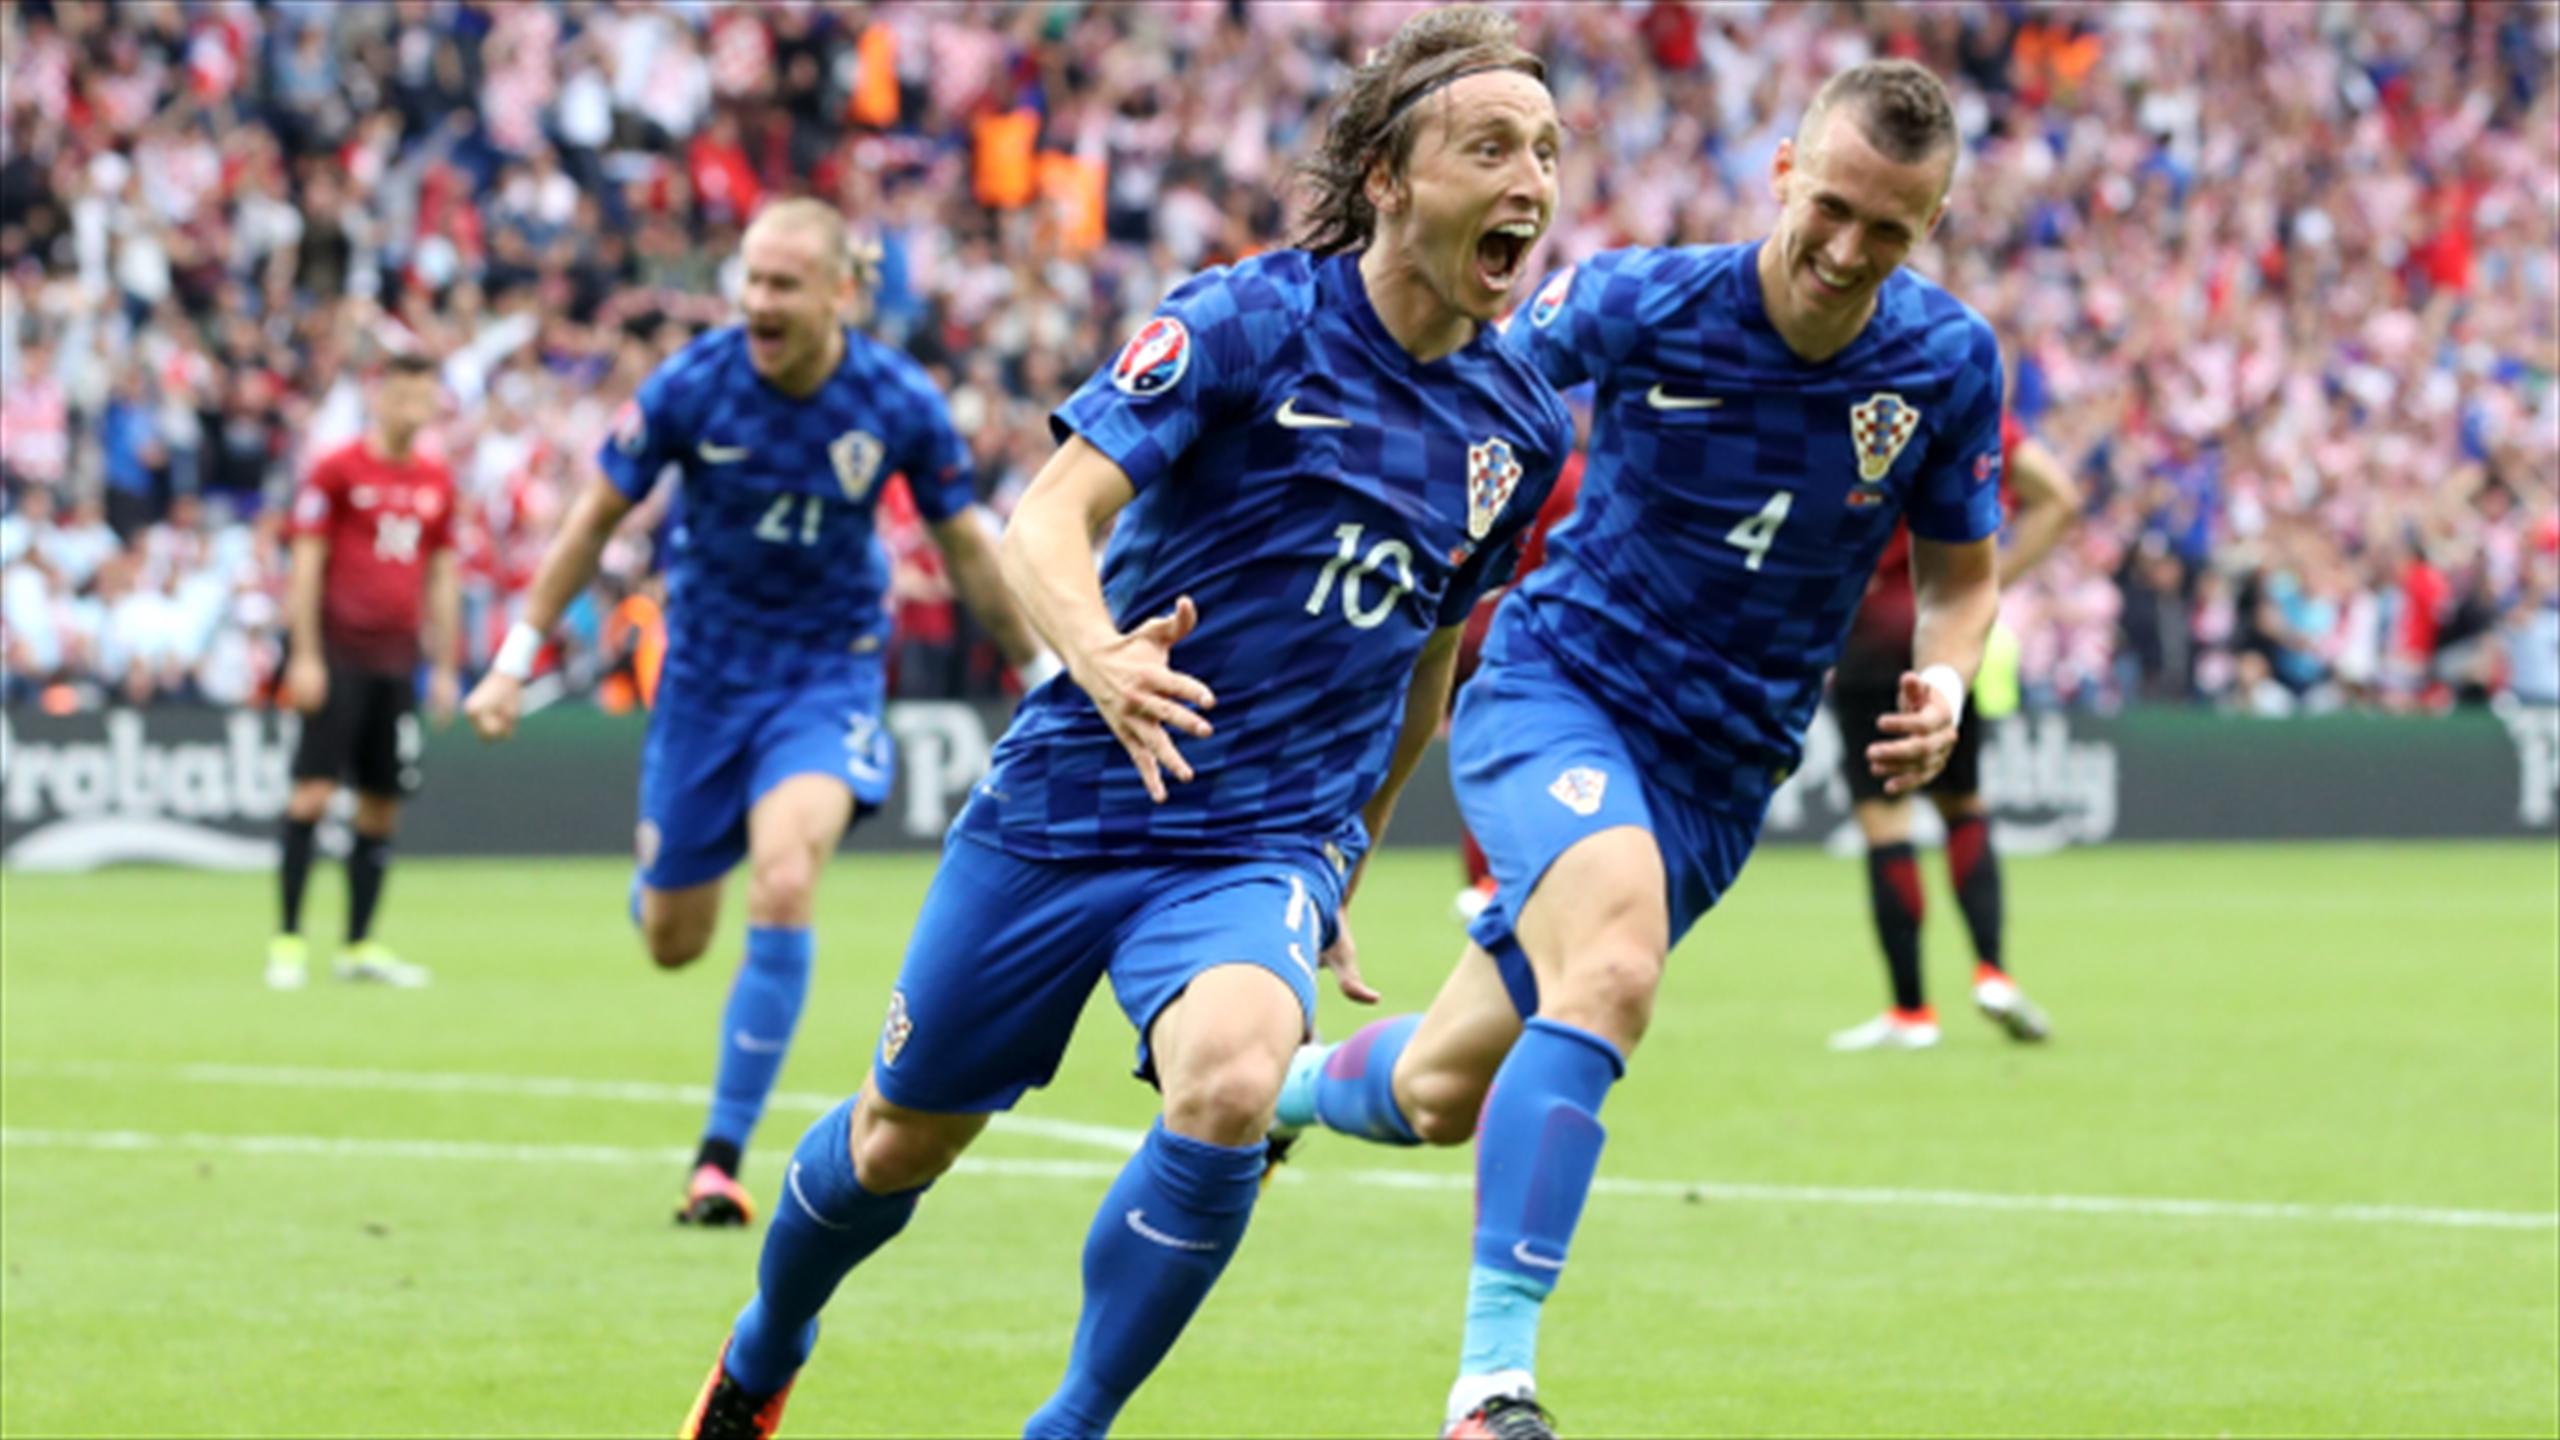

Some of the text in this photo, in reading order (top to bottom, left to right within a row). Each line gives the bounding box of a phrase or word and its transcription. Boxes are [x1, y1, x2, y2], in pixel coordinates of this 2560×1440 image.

[754, 492, 822, 547] 21
[1724, 490, 1794, 572] 4
[1304, 523, 1416, 629] 10
